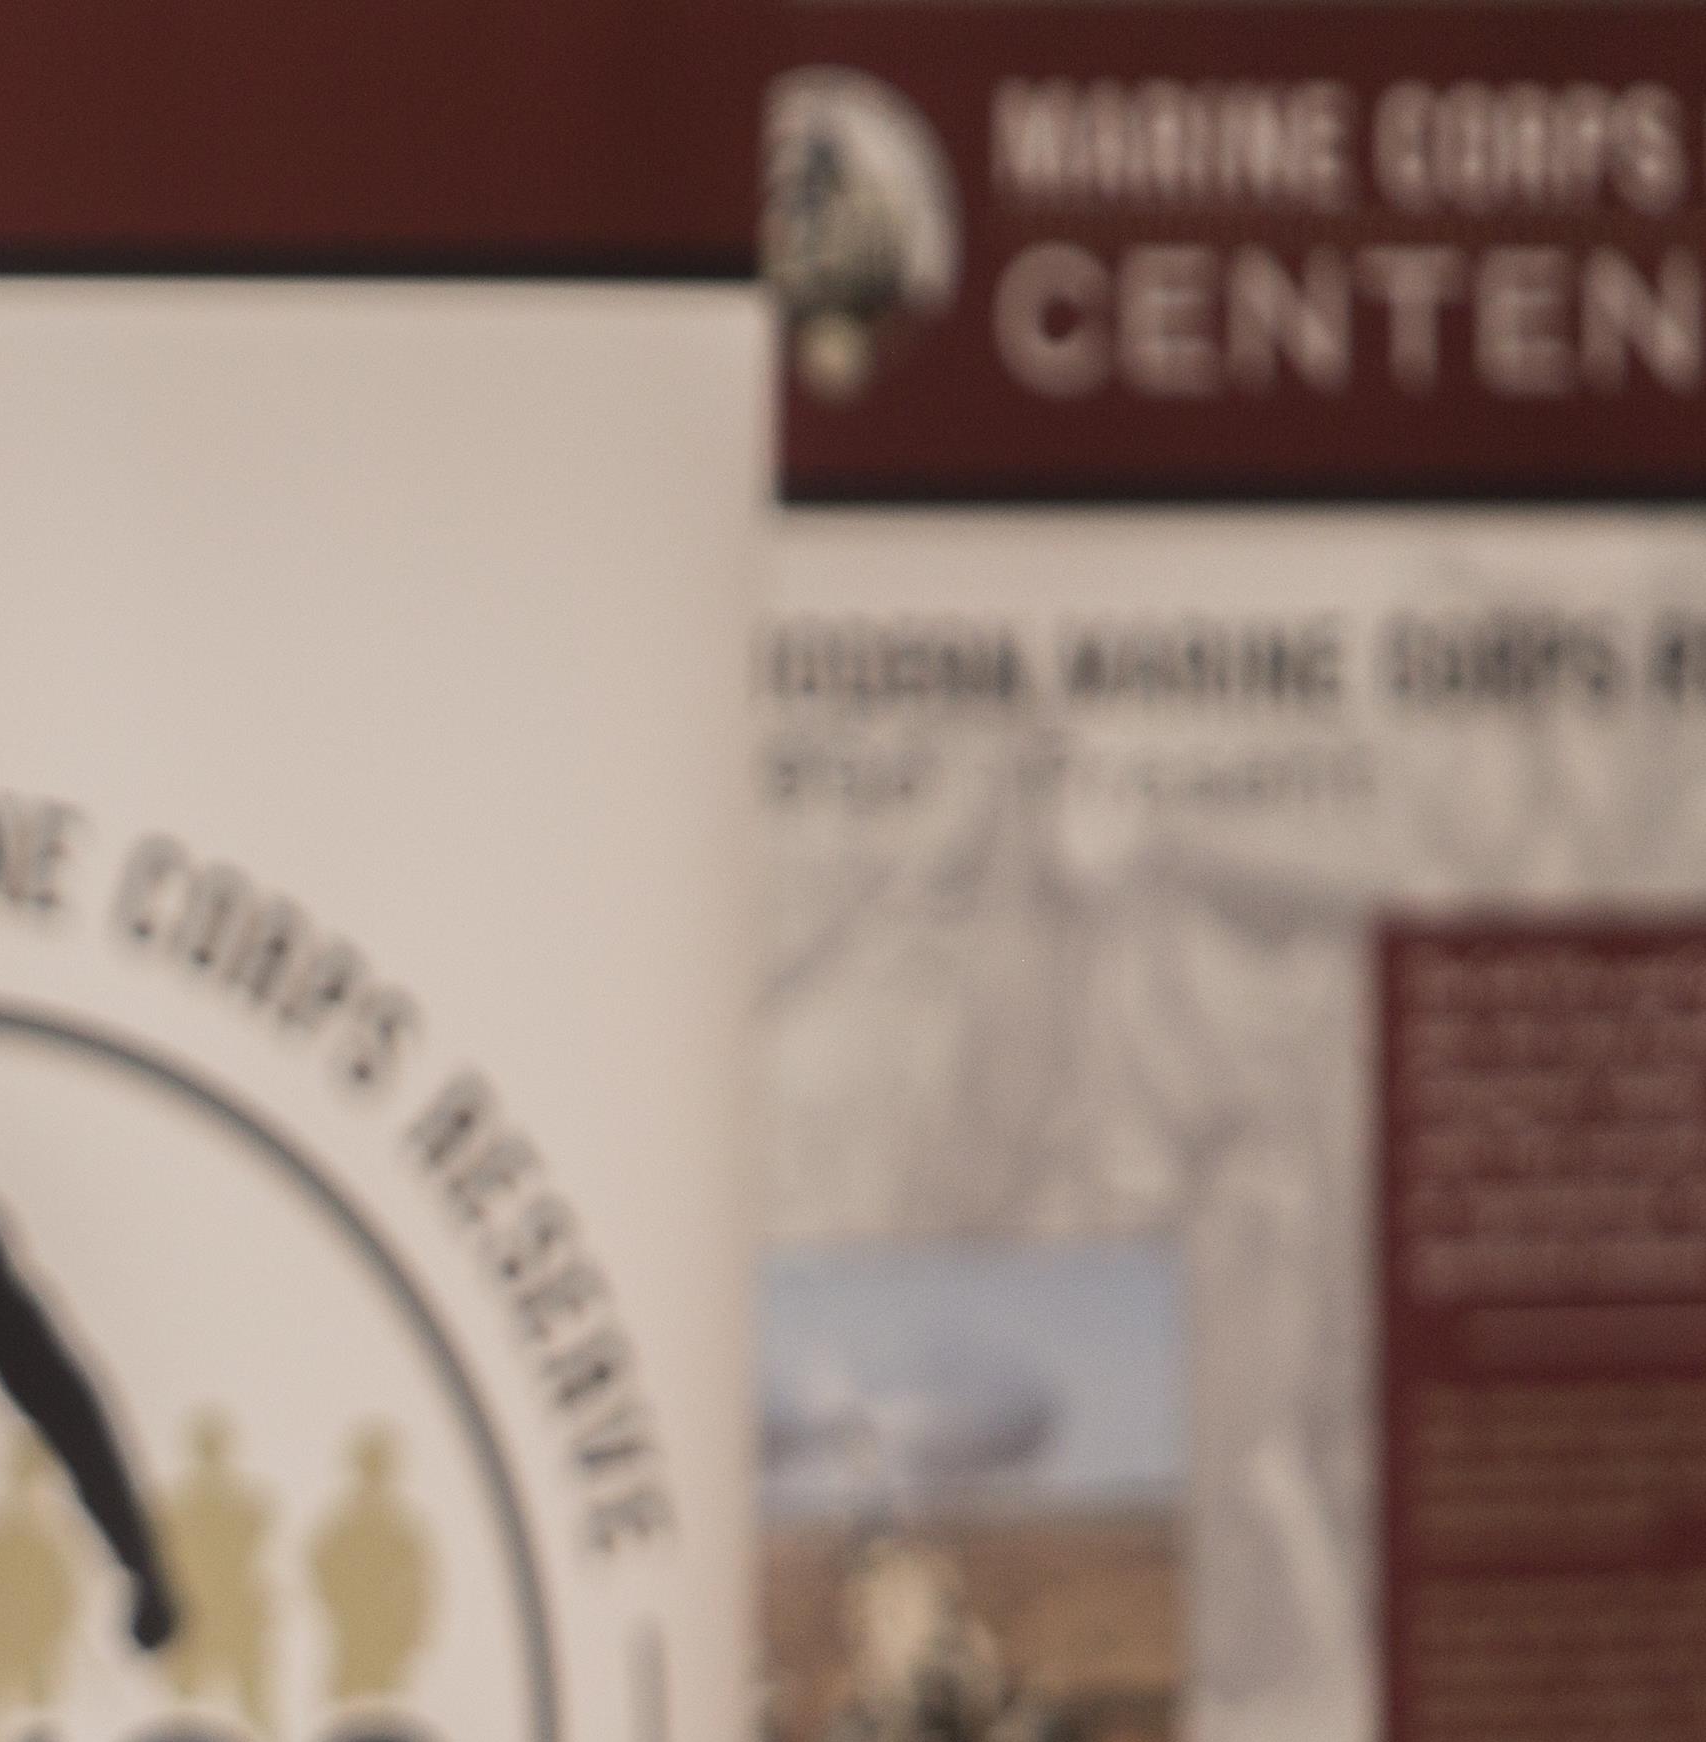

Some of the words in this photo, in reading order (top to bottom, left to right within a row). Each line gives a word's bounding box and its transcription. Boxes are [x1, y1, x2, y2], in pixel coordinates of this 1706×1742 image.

[1375, 80, 1687, 208] CORPS
[995, 245, 1704, 395] CENTEN
[111, 832, 427, 1105] CORPS
[407, 1068, 677, 1562] RESERVE
